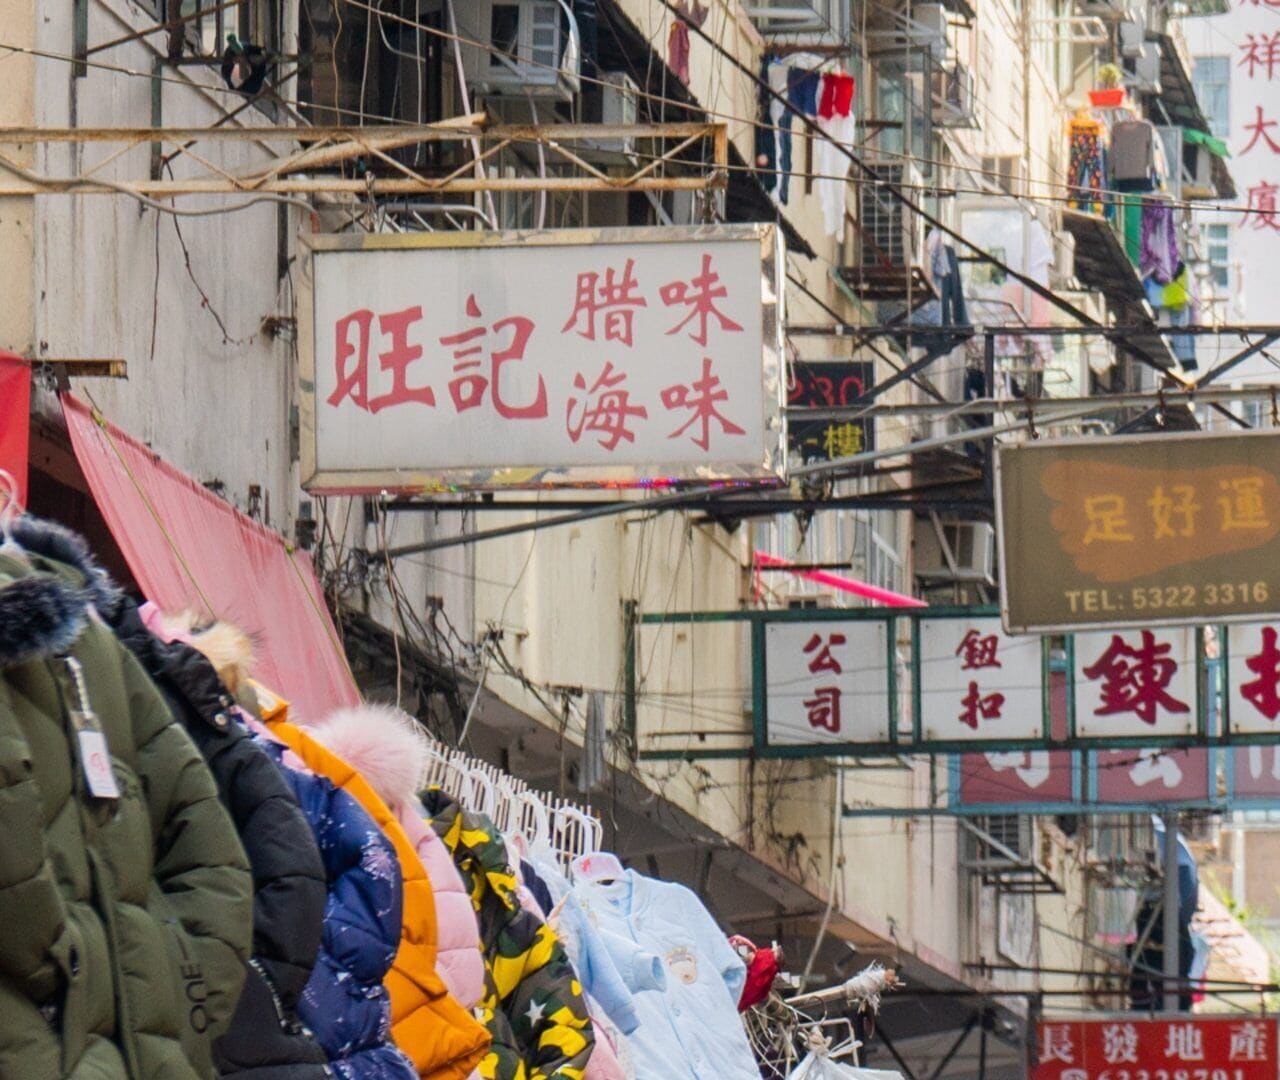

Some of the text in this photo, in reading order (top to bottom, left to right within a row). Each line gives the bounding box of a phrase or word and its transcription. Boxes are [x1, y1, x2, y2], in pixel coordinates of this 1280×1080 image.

[326, 293, 548, 420] 旺記
[565, 357, 746, 452] 海味
[1082, 475, 1271, 546] 足好運
[1065, 581, 1269, 613] TEL: 5322 3316
[1037, 1021, 1269, 1065] 長發地產
